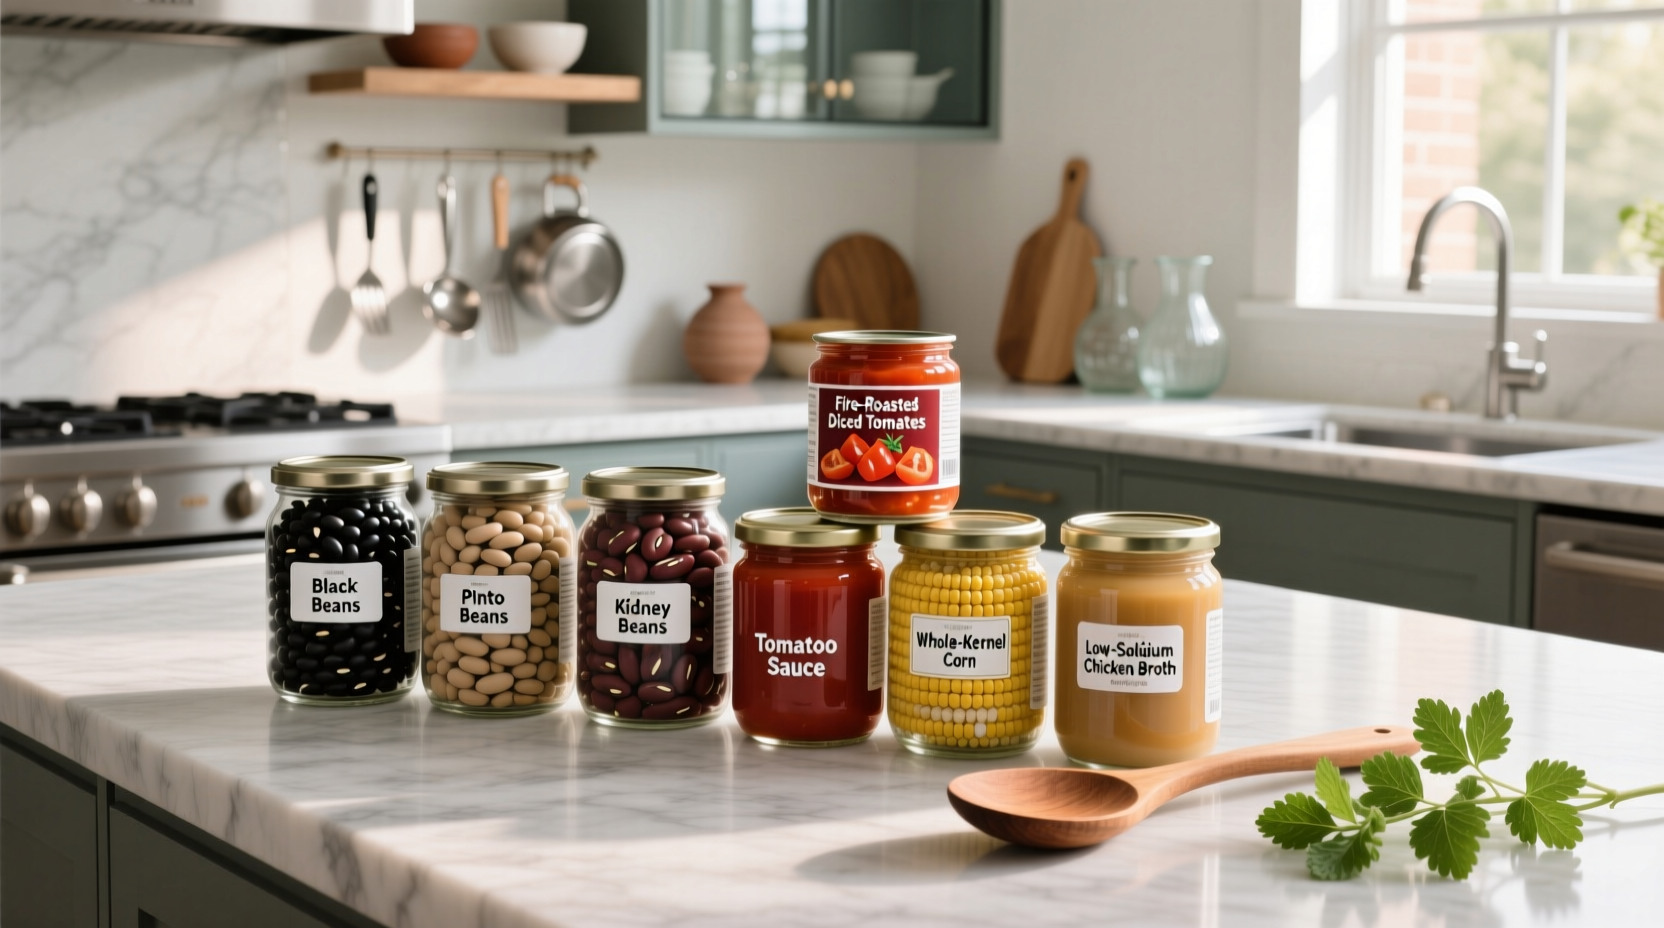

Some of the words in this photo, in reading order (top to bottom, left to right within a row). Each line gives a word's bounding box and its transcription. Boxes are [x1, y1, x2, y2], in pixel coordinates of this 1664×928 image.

[312, 577, 358, 594] Black
[312, 597, 361, 613] Beans
[615, 598, 671, 619] Kidney
[460, 607, 508, 624] Beans
[618, 617, 667, 634] Beans
[754, 632, 838, 654] Tomatoo
[916, 631, 1006, 650] Whole-Kernel
[767, 655, 826, 677] Sauce
[943, 651, 976, 669] Corn
[1084, 658, 1134, 676] Chicken
[1138, 660, 1176, 677] Broth
